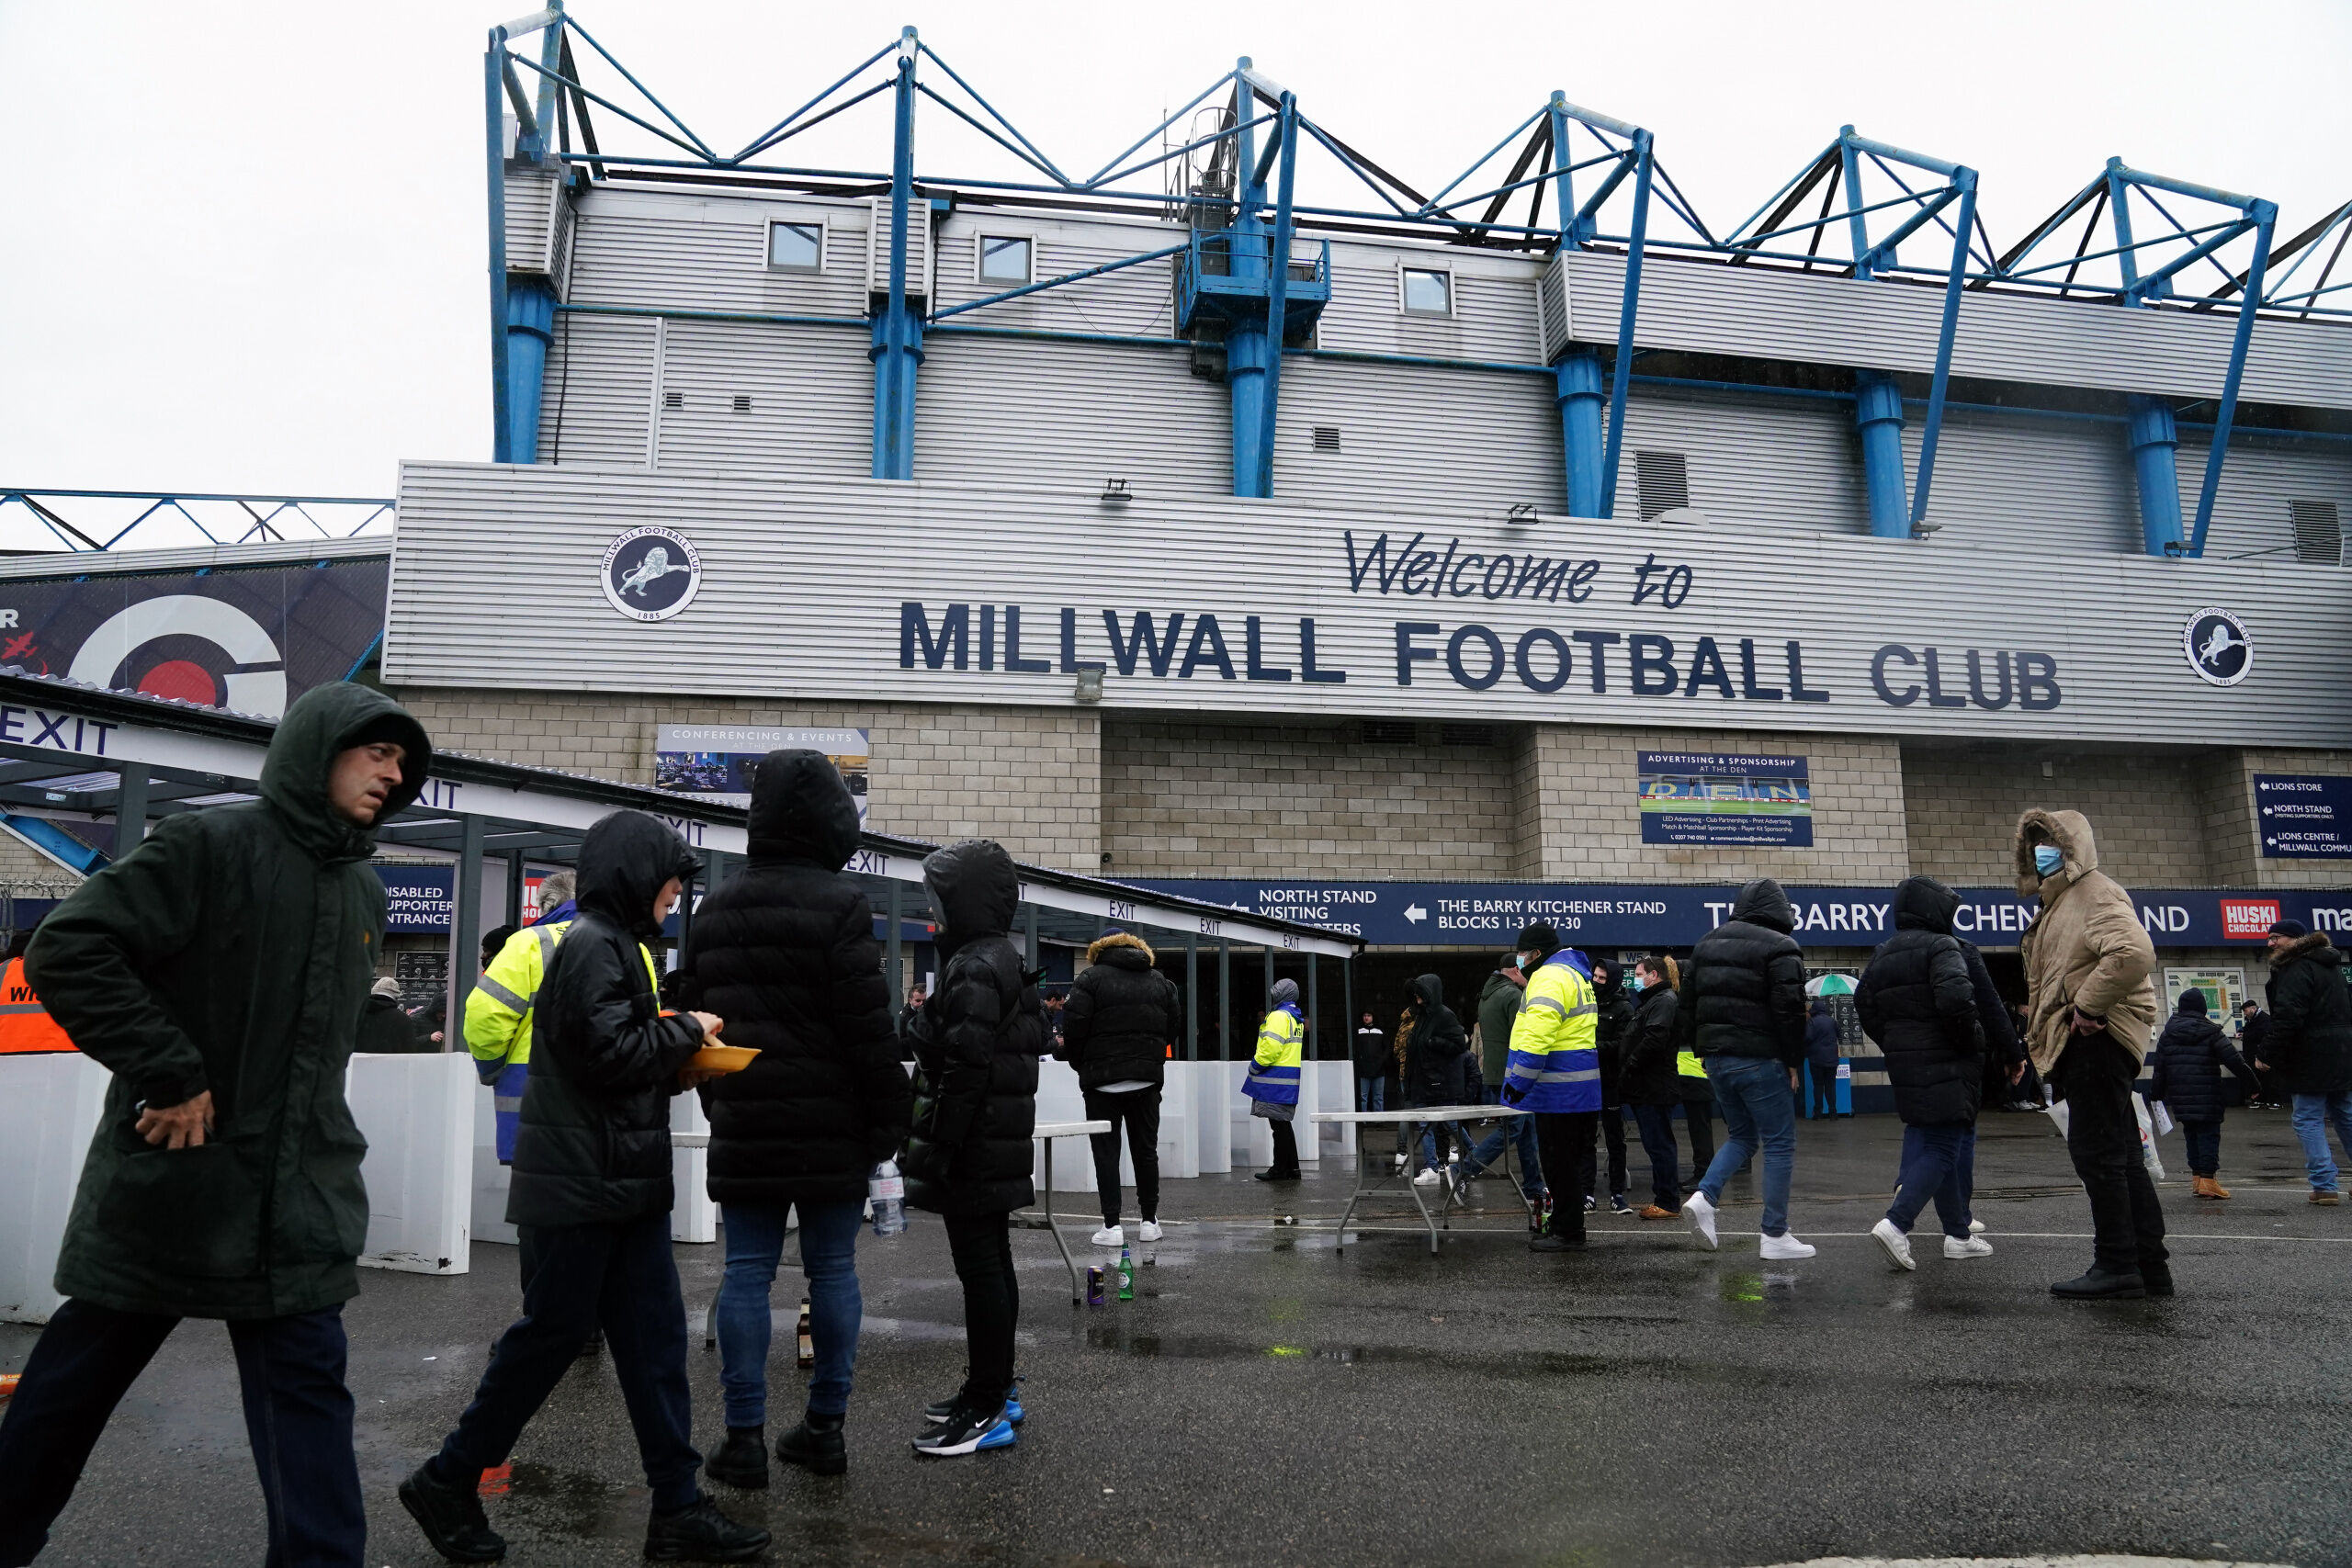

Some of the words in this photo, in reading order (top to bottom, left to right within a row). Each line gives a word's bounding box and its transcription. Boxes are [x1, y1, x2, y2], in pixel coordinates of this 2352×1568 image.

[603, 532, 637, 571] MILLWALL
[638, 527, 689, 548] FOOTBALL
[686, 548, 700, 574] CLUB
[1344, 530, 1600, 604] Welcome
[1632, 553, 1692, 609] to
[638, 612, 661, 620] 1885
[899, 602, 1347, 683] MILLWALL
[1396, 621, 1830, 703] FOOTBALL
[1871, 644, 2063, 711] CLUB
[0, 705, 118, 755] EXIT
[672, 729, 780, 741] CONFERENCING
[786, 732, 795, 741] &
[801, 733, 853, 742] EVENTS
[1647, 755, 1714, 764] ADVERTISING
[1718, 757, 1724, 765] &
[1728, 757, 1796, 767] SPONSORSHIP
[384, 886, 444, 898] ISABLED
[1259, 889, 1318, 903] NORTH
[1322, 890, 1377, 904] STAND
[1109, 899, 1136, 920] EXIT
[1259, 906, 1329, 919] VISITING
[1437, 899, 1469, 912] THE
[1474, 899, 1523, 913] BARRY
[1528, 900, 1613, 914] KITCHENER
[1615, 901, 1667, 914] STAND
[387, 913, 451, 925] NTRANCE
[1791, 903, 1891, 931] BARRY
[2225, 906, 2277, 924] HUSKI
[1200, 918, 1222, 935] EXIT
[1438, 916, 1499, 930] BLOCKS
[1506, 917, 1525, 930] 1-3
[1283, 934, 1300, 951] EXIT
[1625, 952, 1644, 963] W5
